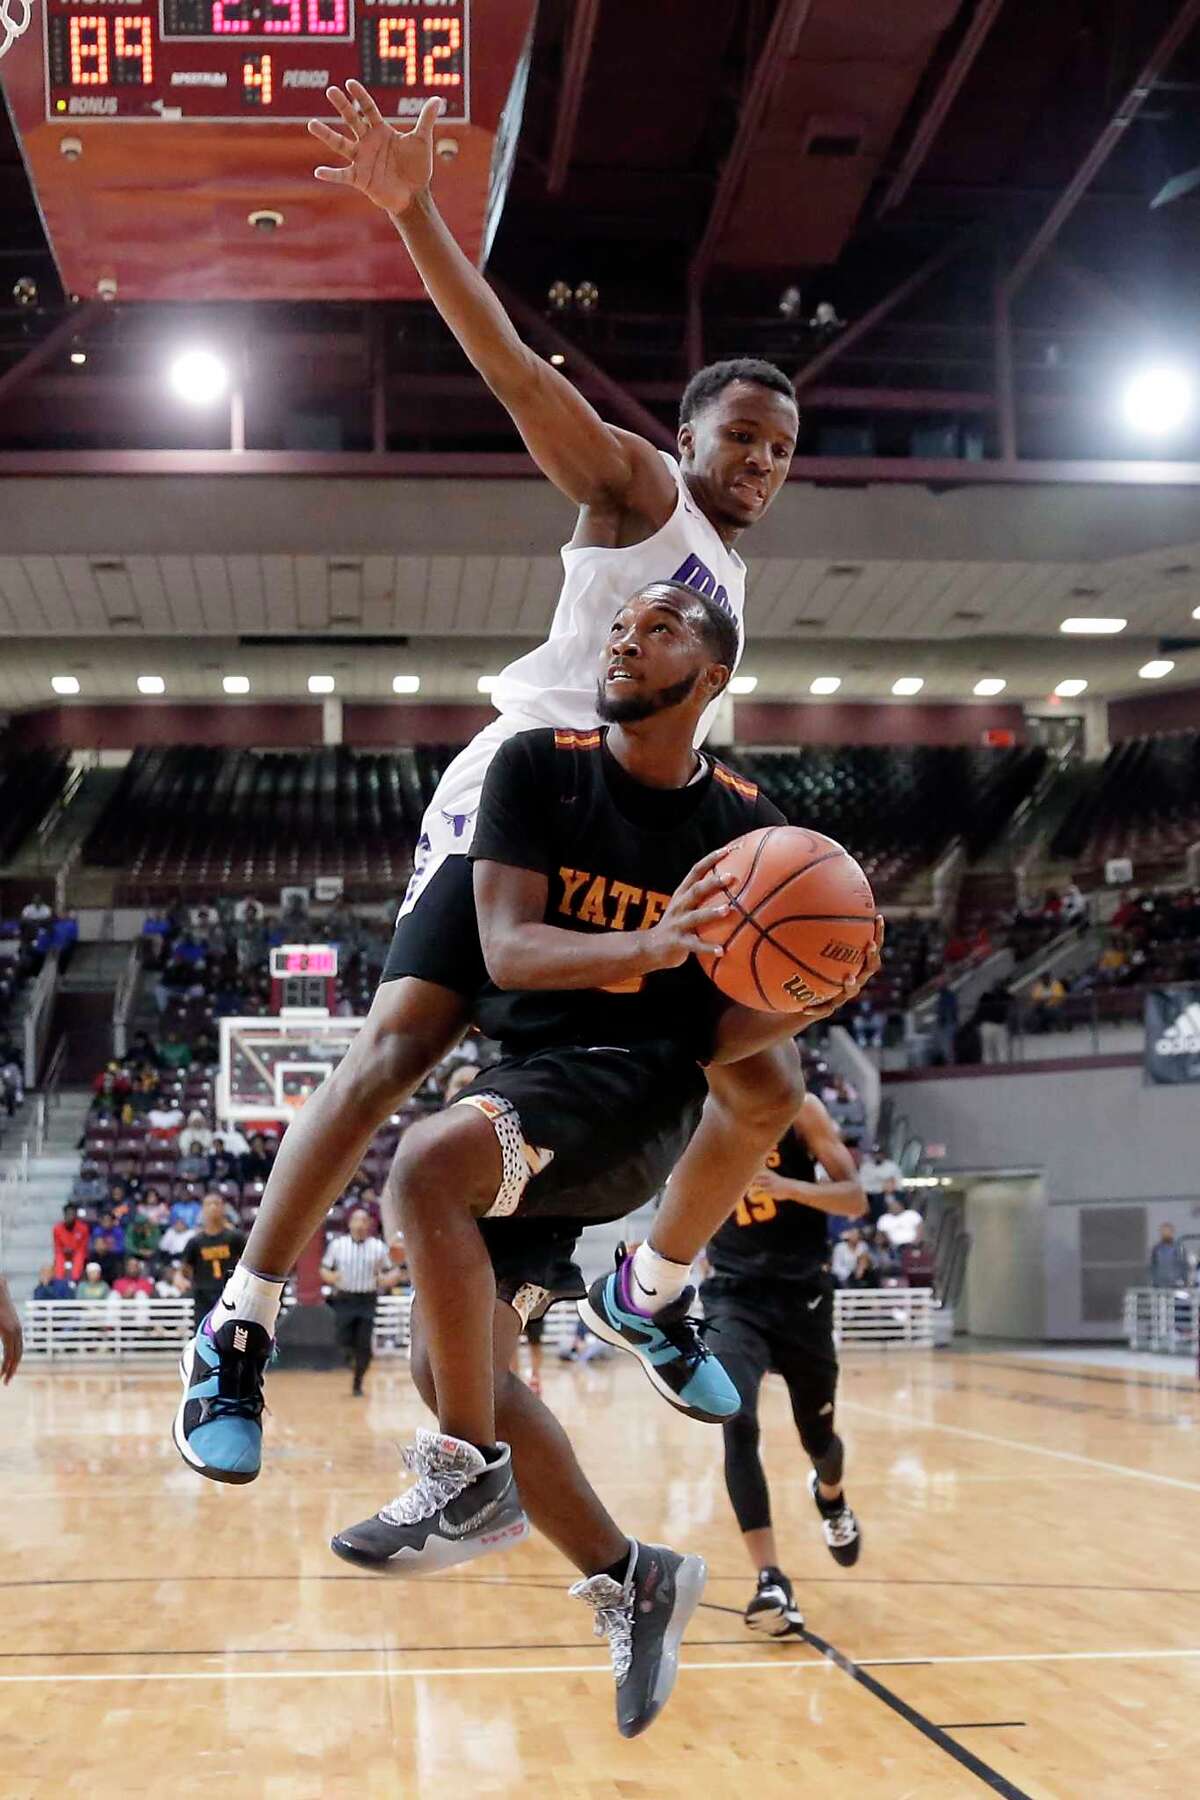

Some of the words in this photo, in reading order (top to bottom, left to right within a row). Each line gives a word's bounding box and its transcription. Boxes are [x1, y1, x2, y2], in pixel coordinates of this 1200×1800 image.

[70, 16, 153, 84] 89
[379, 18, 461, 86] 92
[244, 55, 271, 104] 4
[282, 69, 329, 88] PERIOD
[68, 96, 118, 115] BONUS
[558, 866, 672, 931] YATE
[233, 1325, 249, 1353] NIKE
